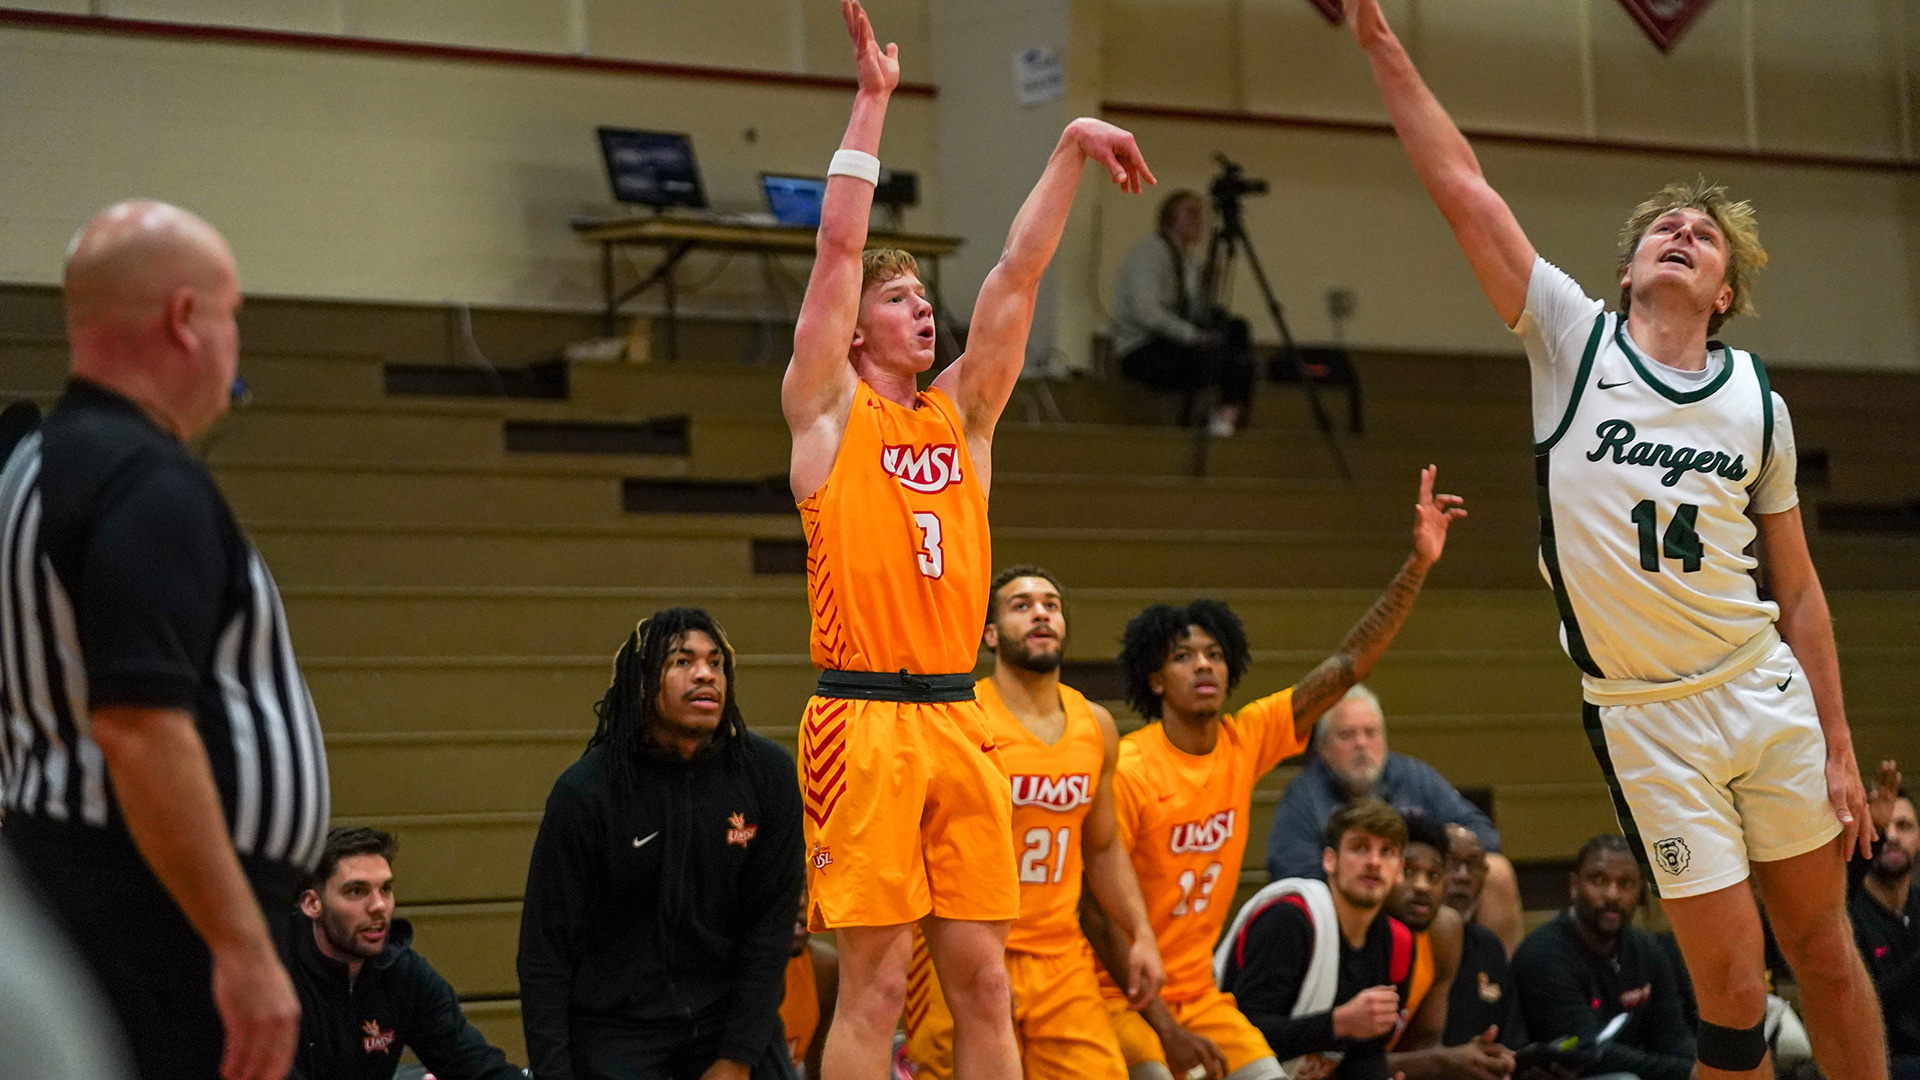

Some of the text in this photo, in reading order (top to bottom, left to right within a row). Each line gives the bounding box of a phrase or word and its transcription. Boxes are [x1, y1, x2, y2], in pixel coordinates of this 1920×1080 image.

[881, 443, 963, 494] UMSL
[1586, 419, 1748, 487] Rangers
[913, 511, 945, 580] 3
[1631, 499, 1705, 573] 14
[1011, 773, 1092, 812] UMSL
[1019, 826, 1070, 884] 21
[1171, 861, 1223, 918] 13
